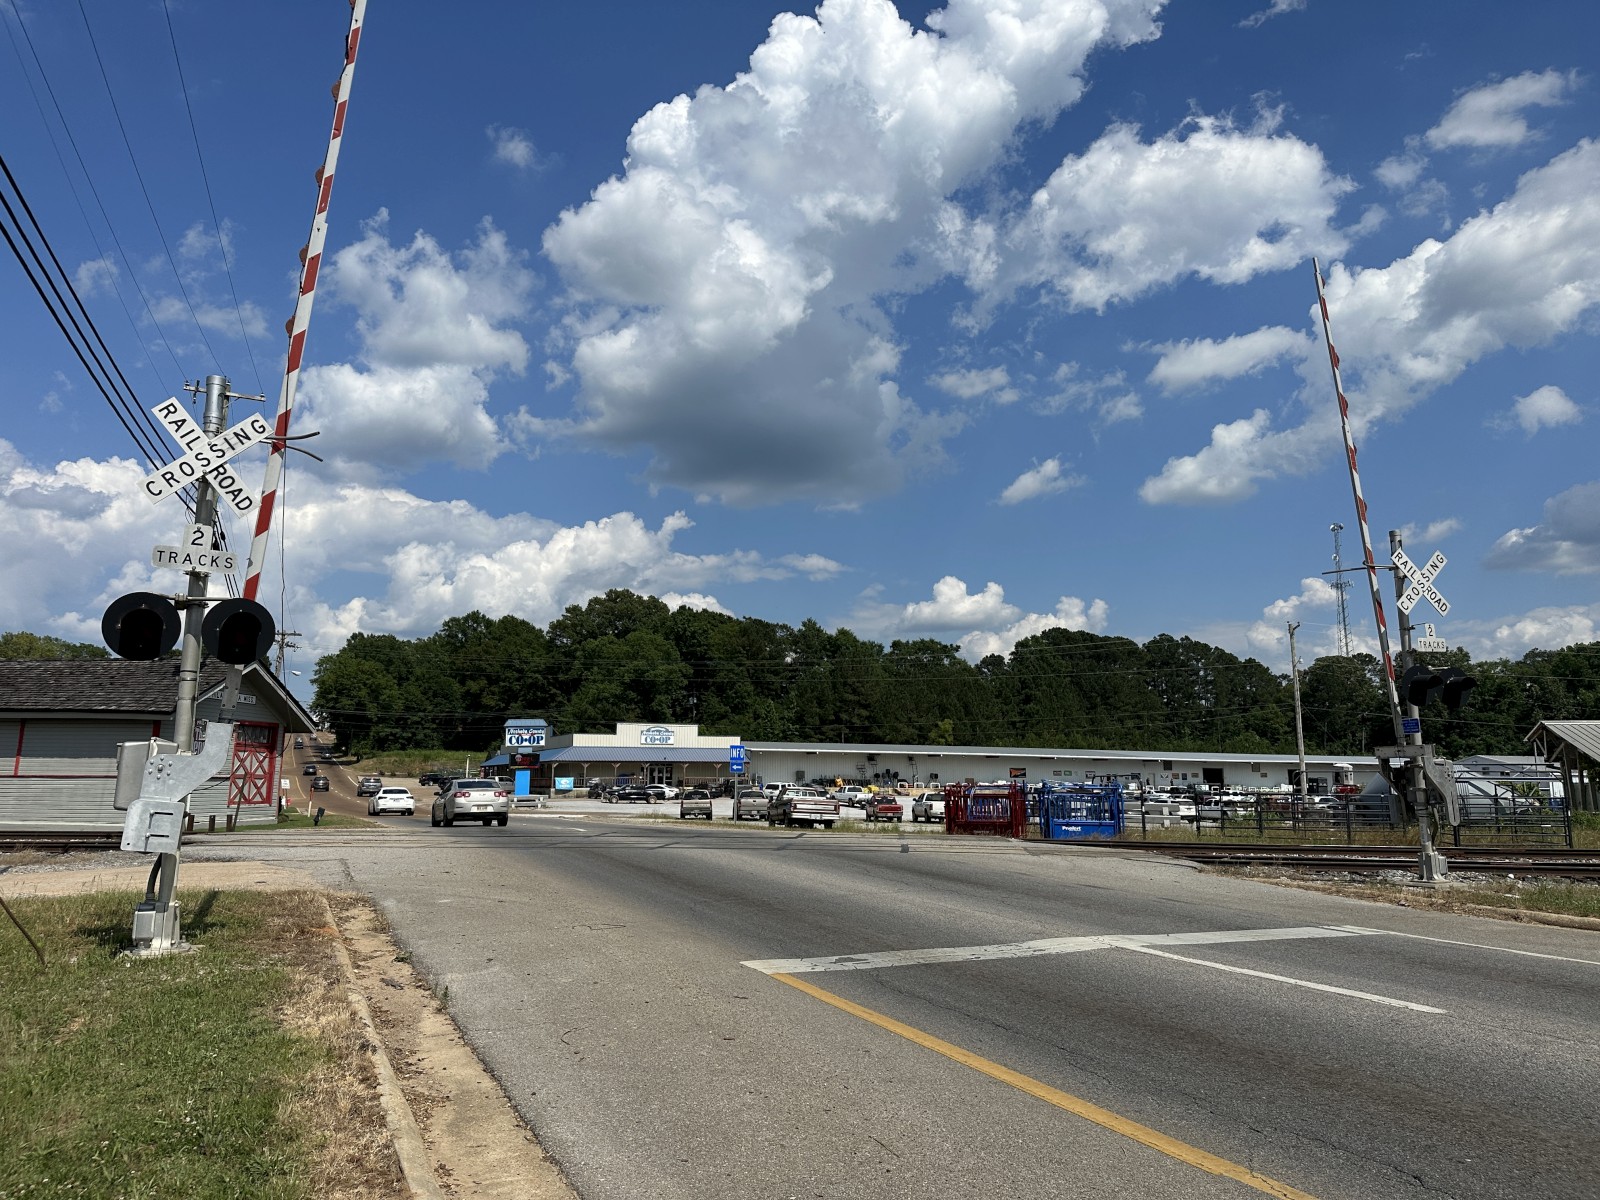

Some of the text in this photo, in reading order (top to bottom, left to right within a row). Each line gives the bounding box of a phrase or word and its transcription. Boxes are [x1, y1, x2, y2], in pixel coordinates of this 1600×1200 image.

[145, 419, 267, 498] CROSSING
[190, 529, 205, 546] 2
[156, 550, 234, 569] TRACKS
[1400, 554, 1444, 611] CROSSING
[1427, 627, 1434, 636] 2
[1419, 640, 1446, 649] TRACKS
[730, 748, 744, 758] INFO
